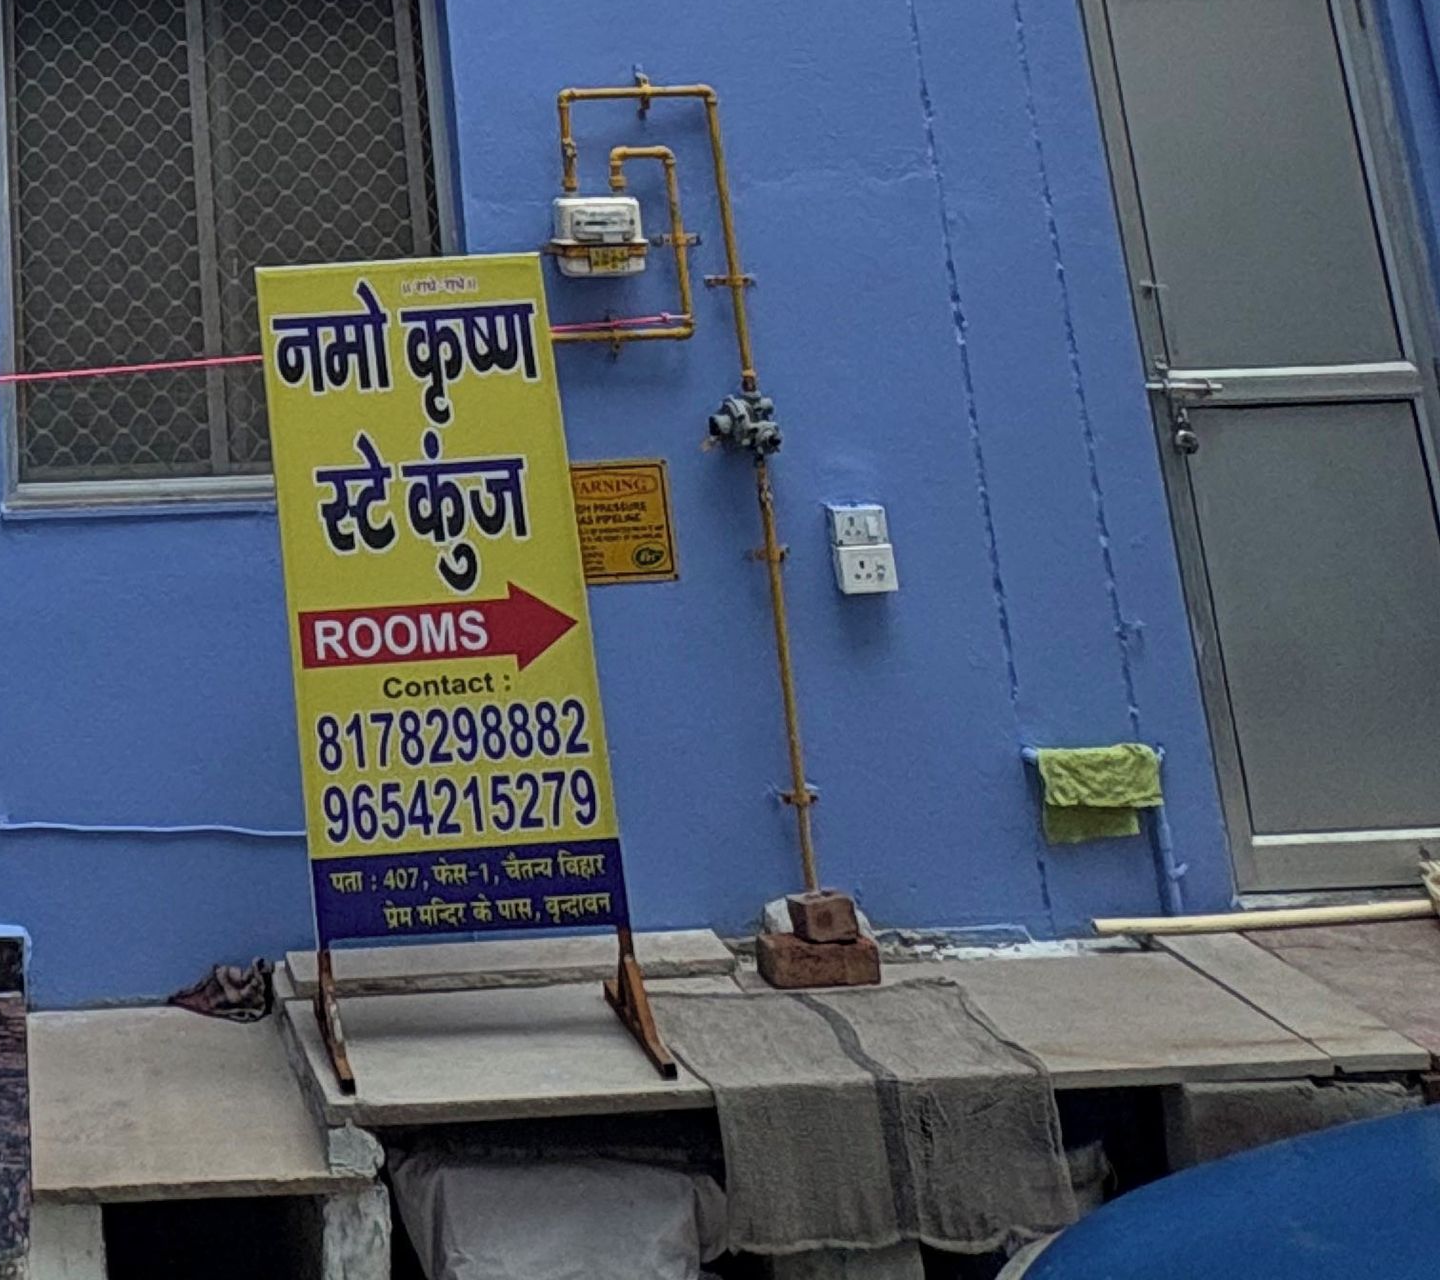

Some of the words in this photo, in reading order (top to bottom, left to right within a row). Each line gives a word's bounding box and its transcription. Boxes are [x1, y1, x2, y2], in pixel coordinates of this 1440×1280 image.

[272, 281, 392, 395] नमो
[399, 301, 540, 425] कृष्ण
[316, 433, 398, 554] स्टे
[401, 430, 532, 591] कुंज
[576, 479, 649, 494] ARNING
[314, 611, 489, 661] ROOMS
[383, 674, 494, 699] Contact
[317, 698, 591, 772] 8178298882
[323, 769, 598, 844] 9654215279
[330, 871, 364, 893] पता
[558, 850, 605, 878] विहार
[383, 900, 412, 929] प्रेम
[470, 894, 493, 922] के
[544, 892, 611, 924] वृन्दावन
